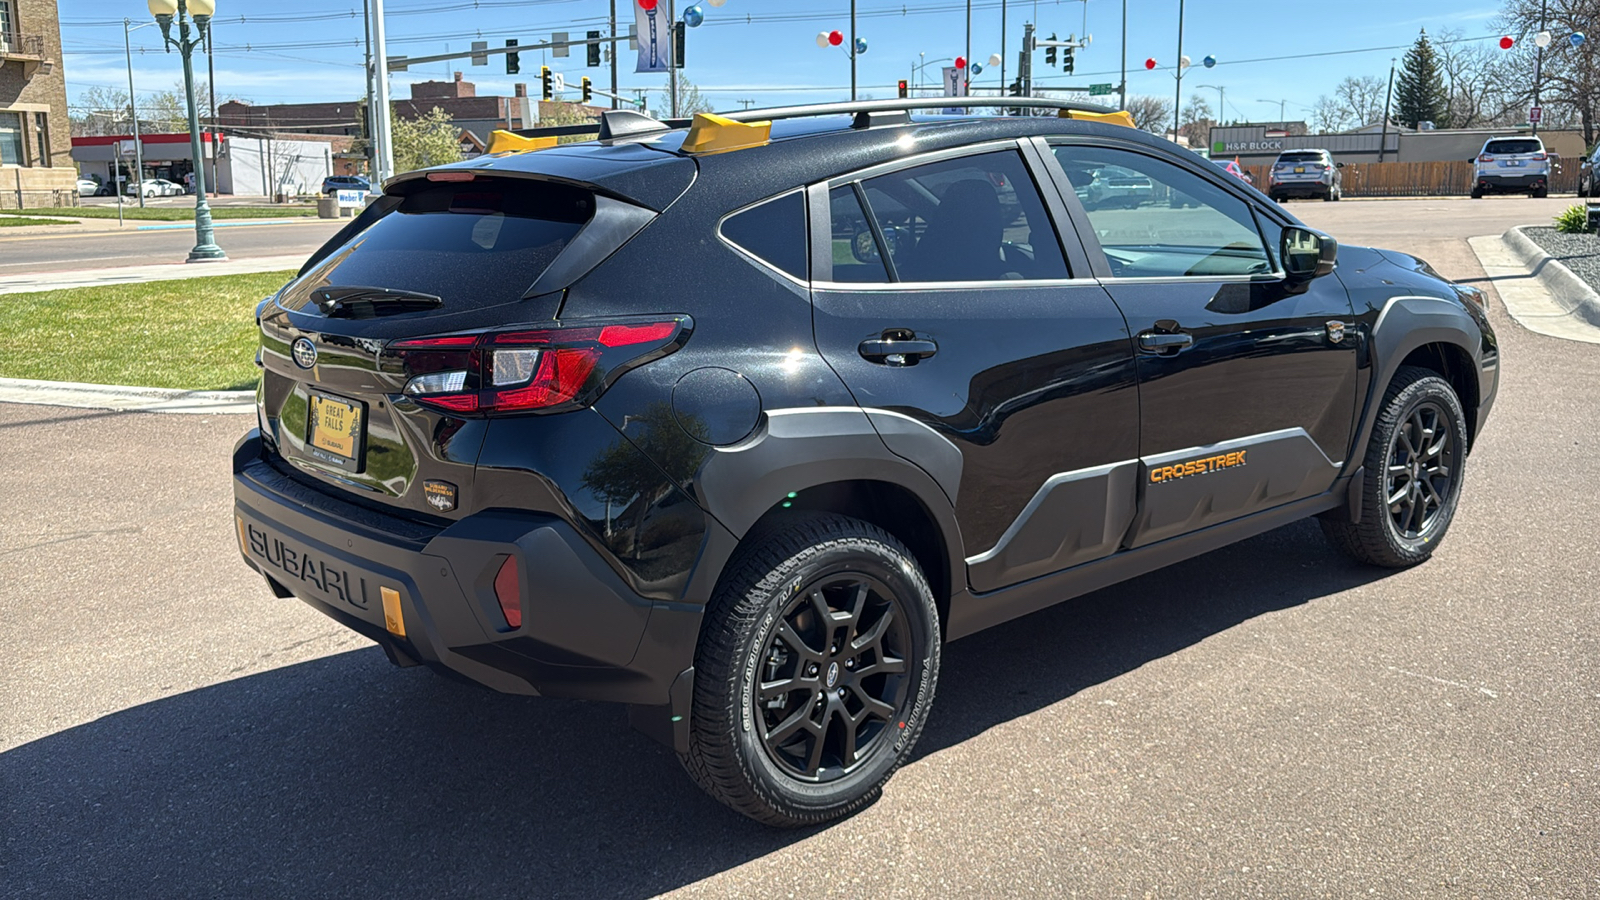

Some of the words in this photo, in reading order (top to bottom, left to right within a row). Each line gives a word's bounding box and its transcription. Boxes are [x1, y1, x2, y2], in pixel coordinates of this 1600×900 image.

[1225, 142, 1247, 151] H&R
[1249, 141, 1282, 150] BLOCK
[340, 193, 357, 201] Weber
[325, 404, 344, 419] GREAT
[324, 416, 344, 432] FALLS
[1150, 450, 1247, 482] CROSSTREK
[424, 486, 454, 496] WILDERNESS
[429, 482, 448, 491] SUBARU
[248, 523, 369, 611] SUBARU
[742, 613, 773, 731] GEOLANDAR
[895, 656, 931, 751] YOKOHAMA
